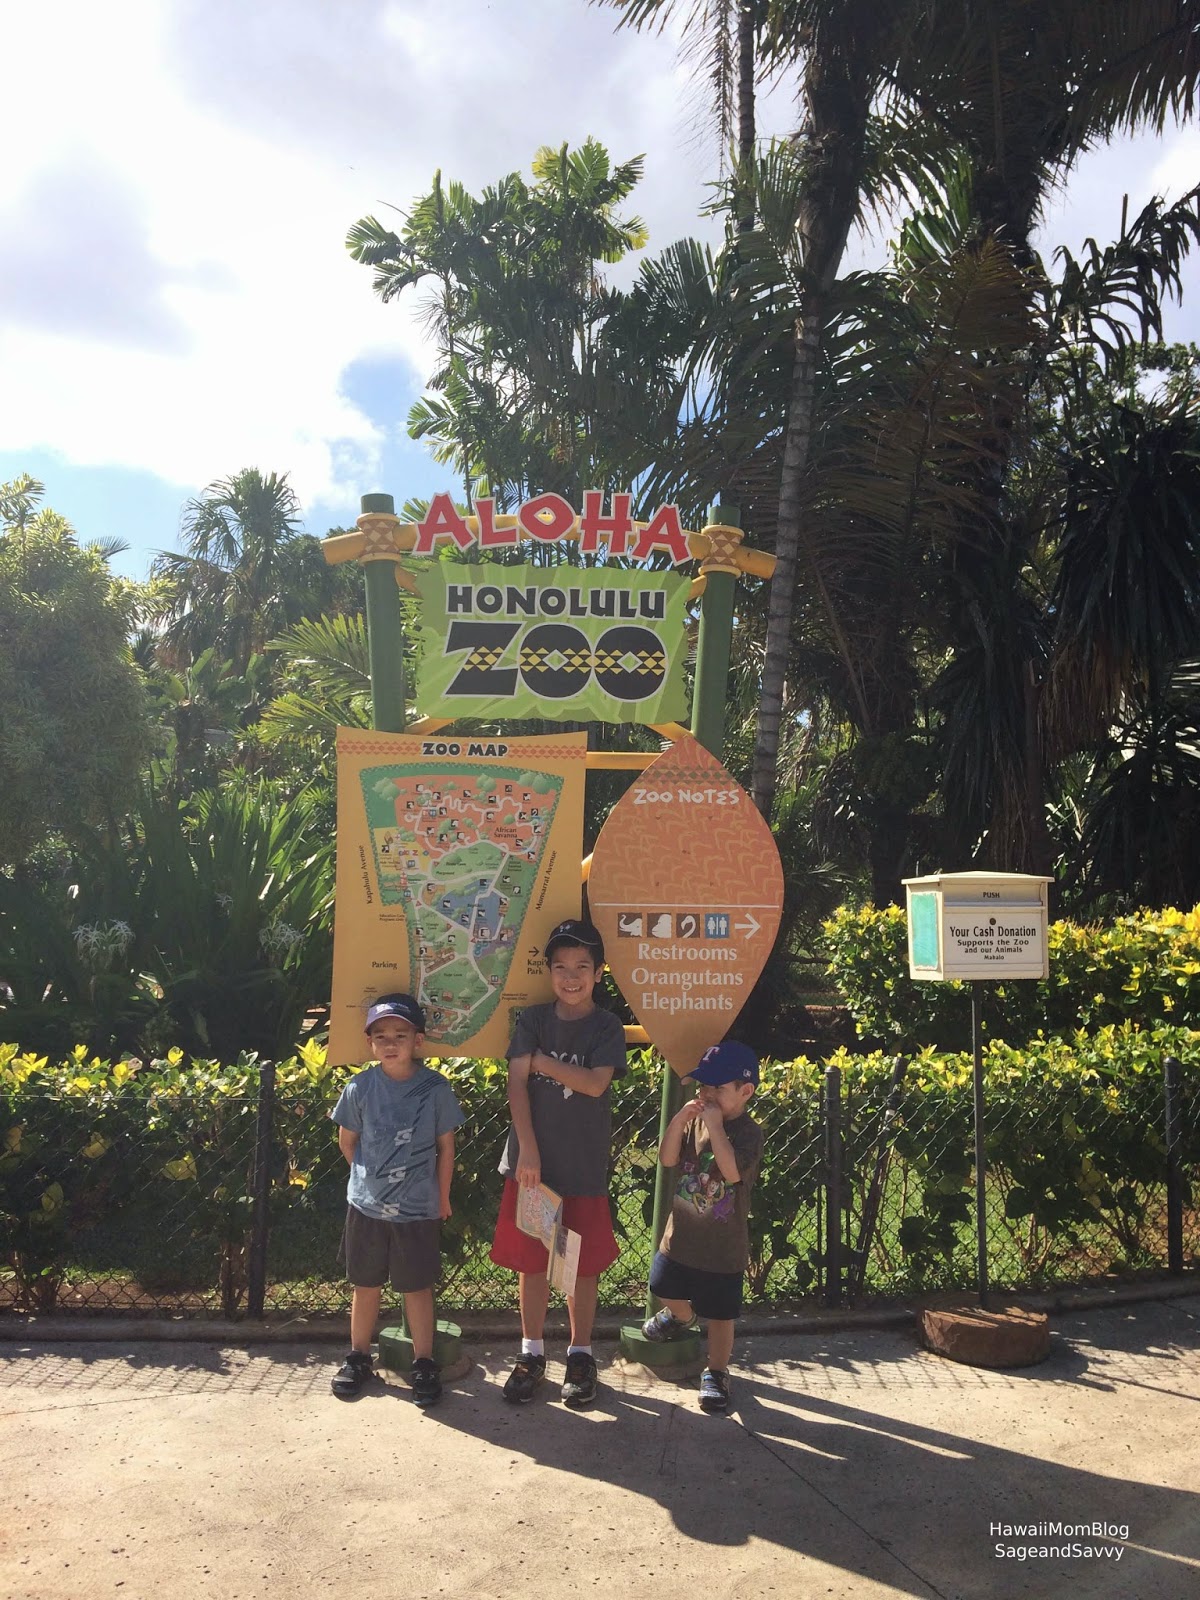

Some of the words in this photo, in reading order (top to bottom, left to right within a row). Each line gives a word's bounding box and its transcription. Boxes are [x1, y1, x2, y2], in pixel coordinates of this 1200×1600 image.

[412, 489, 693, 566] ALOHA
[446, 584, 665, 620] HONOLULU
[444, 620, 669, 703] ZOO
[422, 742, 462, 757] ZOO
[467, 742, 509, 758] MAP
[359, 846, 368, 870] Avenue
[547, 850, 557, 876] Avenue
[950, 926, 969, 937] Your
[973, 926, 994, 937] Cash
[998, 926, 1036, 937] Donation
[638, 943, 737, 961] Restrooms
[957, 939, 993, 947] Supports
[371, 961, 398, 970] Parking
[527, 967, 543, 975] Park
[631, 967, 744, 990] Orangutans
[641, 992, 733, 1015] Elephants
[702, 1046, 720, 1061] T
